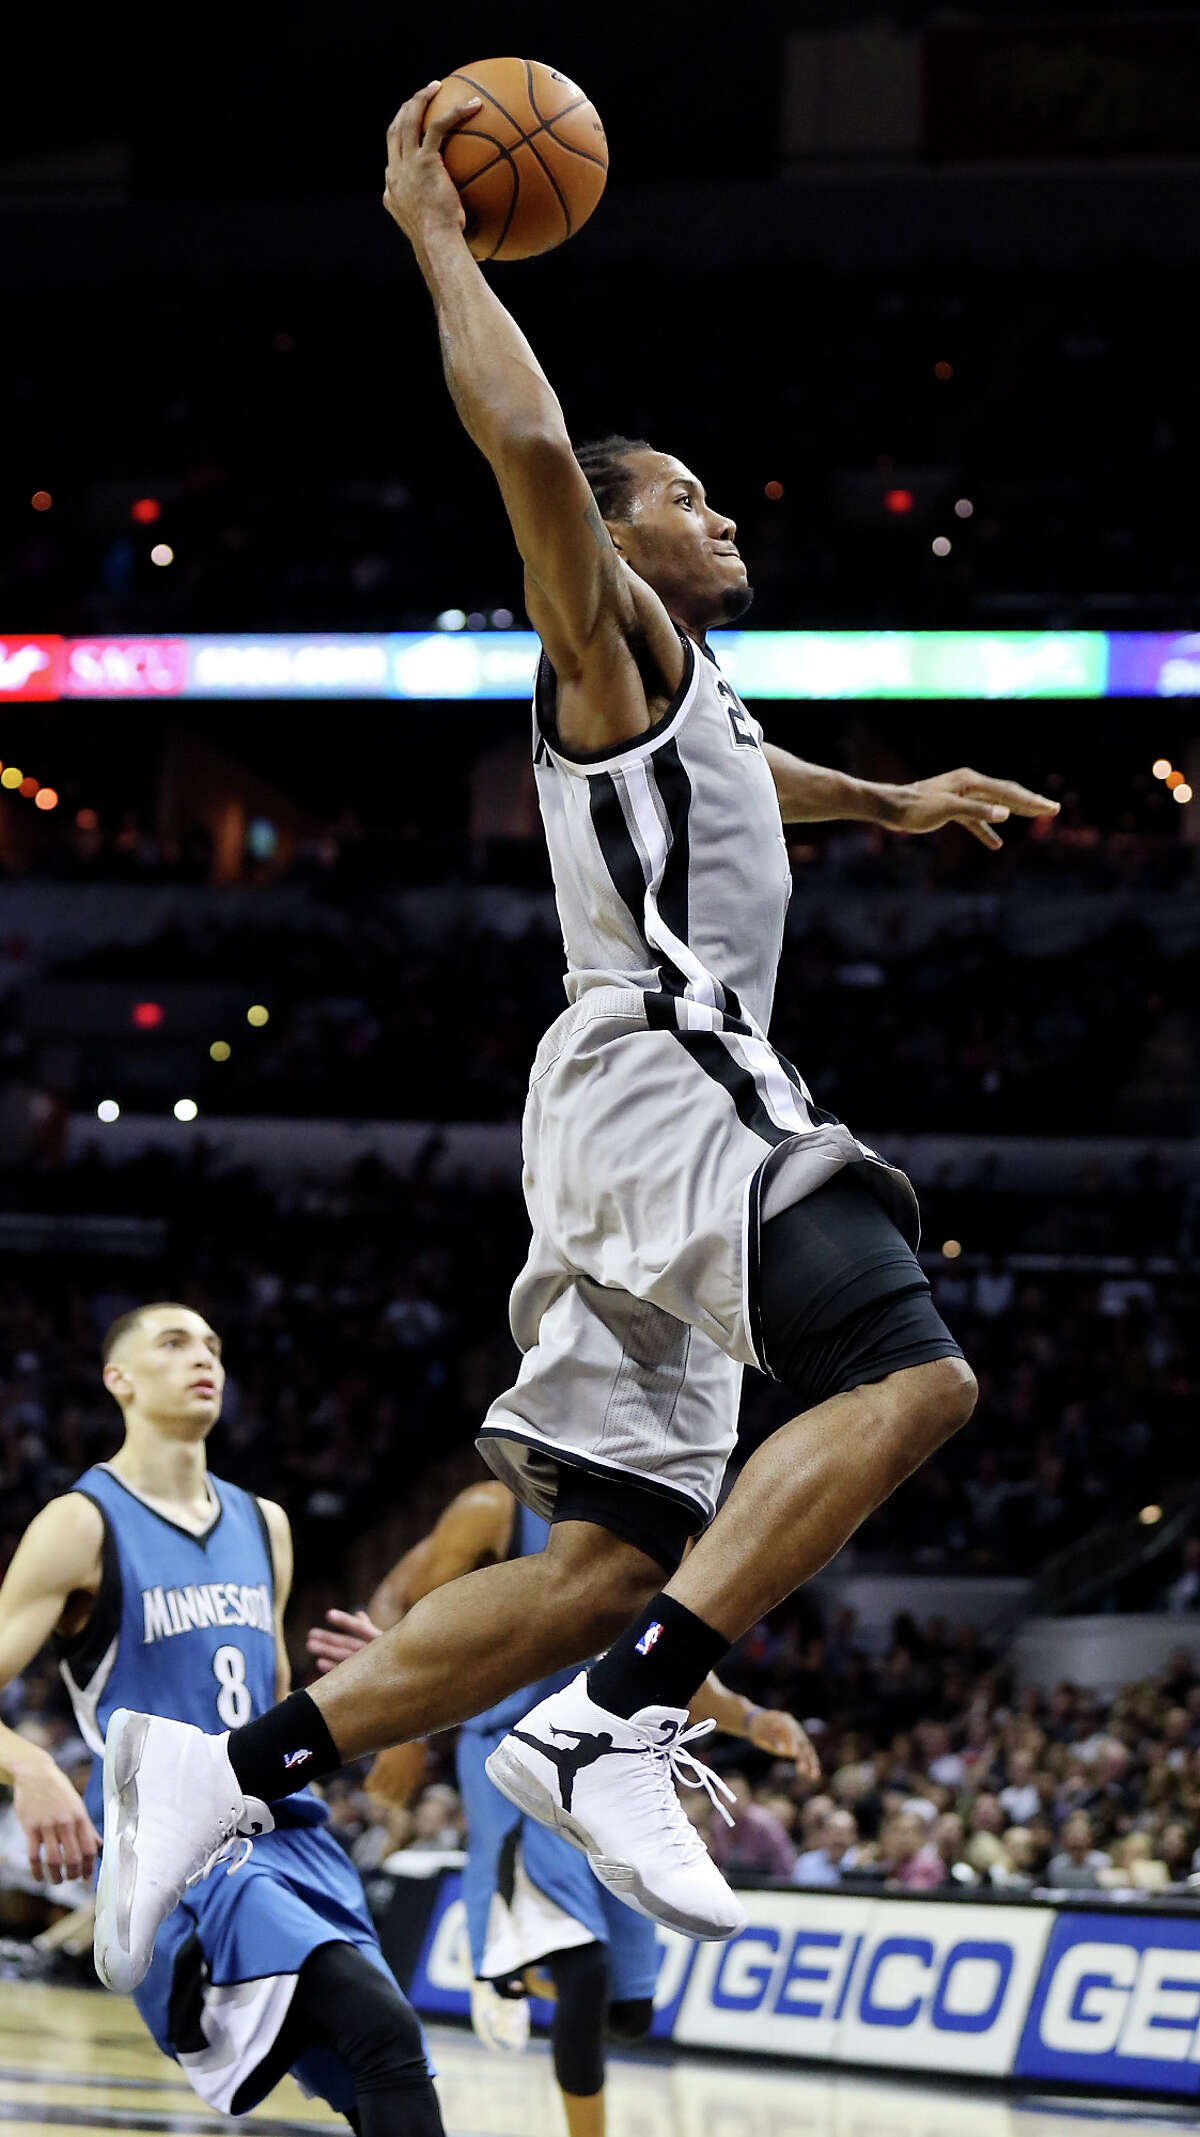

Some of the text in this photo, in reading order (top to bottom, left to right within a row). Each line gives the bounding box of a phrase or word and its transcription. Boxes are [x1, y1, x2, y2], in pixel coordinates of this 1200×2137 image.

[714, 678, 760, 752] 2
[213, 1645, 251, 1729] 8
[711, 1926, 1015, 2033] GEICO
